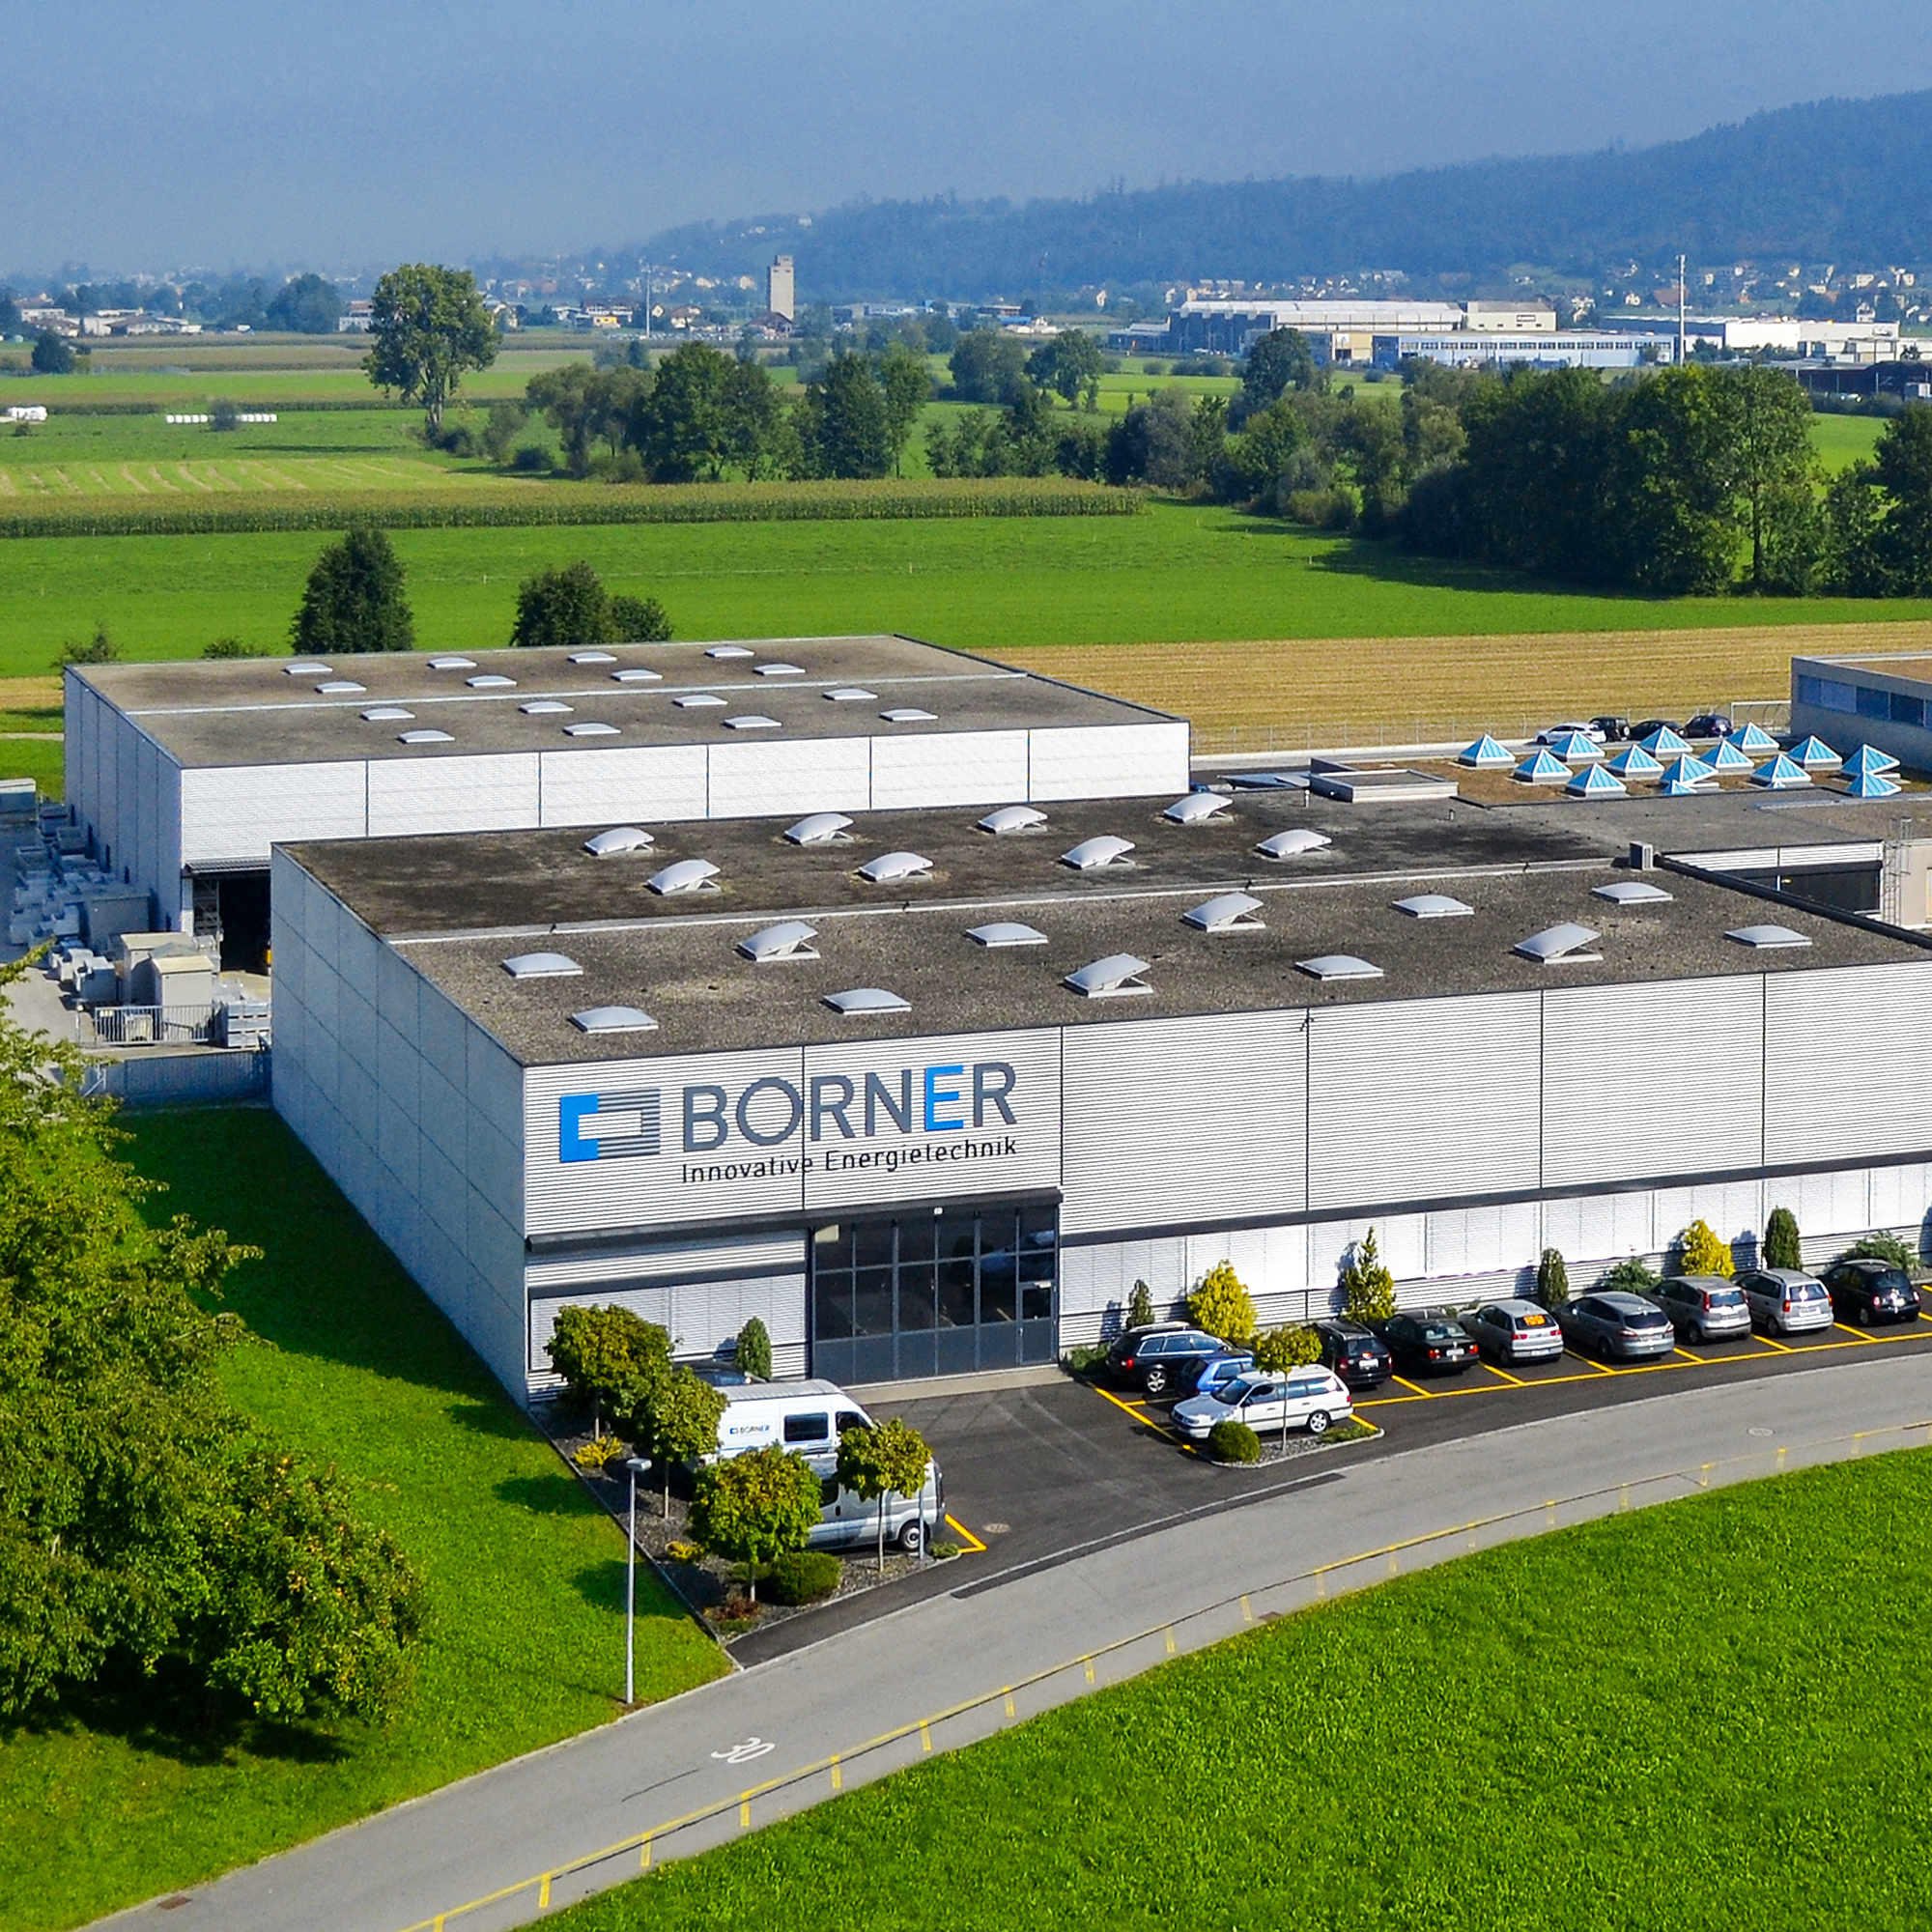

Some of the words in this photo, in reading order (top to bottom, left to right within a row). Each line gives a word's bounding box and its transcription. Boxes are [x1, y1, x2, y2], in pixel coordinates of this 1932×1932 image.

[683, 1063, 1016, 1151] BORNER
[682, 1155, 812, 1183] Innovative
[825, 1137, 1017, 1172] Energietechnik
[711, 1736, 776, 1764] 30
